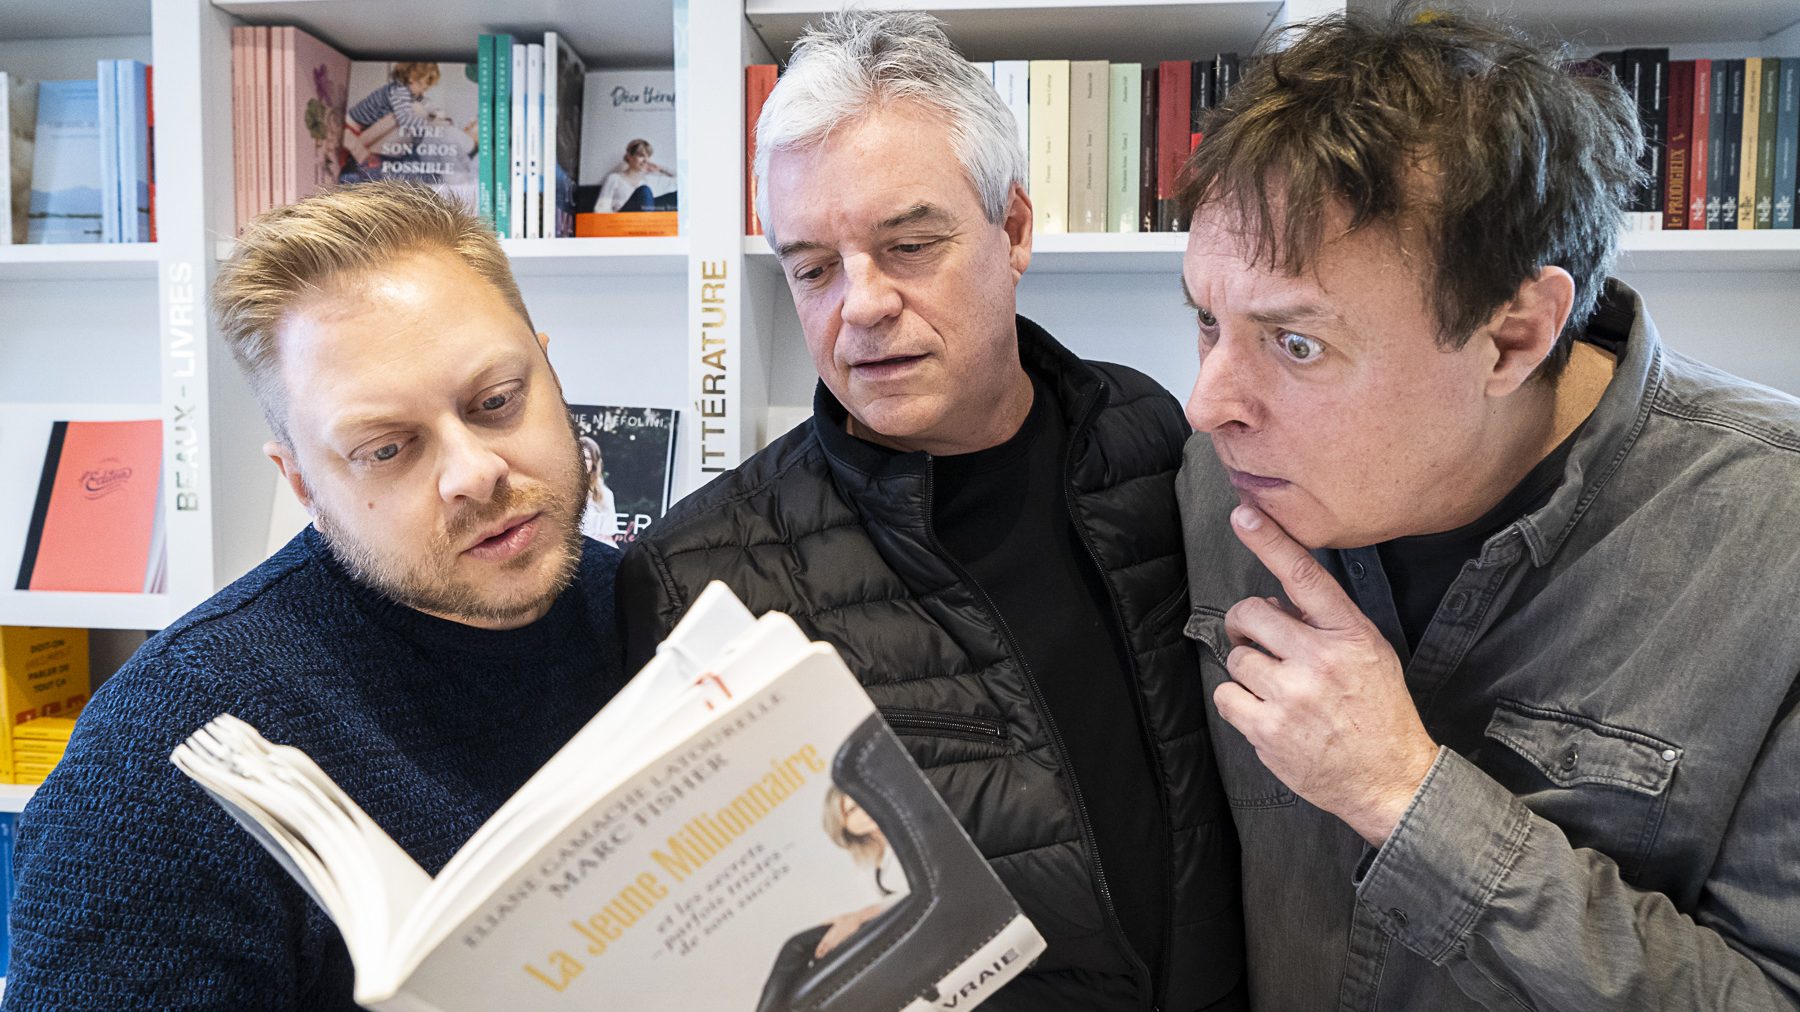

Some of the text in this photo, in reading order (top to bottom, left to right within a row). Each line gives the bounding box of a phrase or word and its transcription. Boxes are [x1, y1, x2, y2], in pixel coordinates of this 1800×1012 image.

[381, 143, 459, 157] SON GROS
[381, 160, 456, 176] POSSIBLE
[168, 261, 195, 378] LIVRES
[695, 260, 728, 473] ITTÉRATURE
[541, 786, 645, 878] GAMACHE
[651, 692, 783, 787] LATOURELLE
[547, 752, 729, 899] MARC FISHER
[523, 742, 828, 992] La Jeune Millionnaire
[674, 893, 702, 916] les
[705, 843, 765, 893] secrets
[728, 851, 781, 896] tristes
[704, 908, 735, 936] son
[943, 947, 1019, 1009] VRAIE
